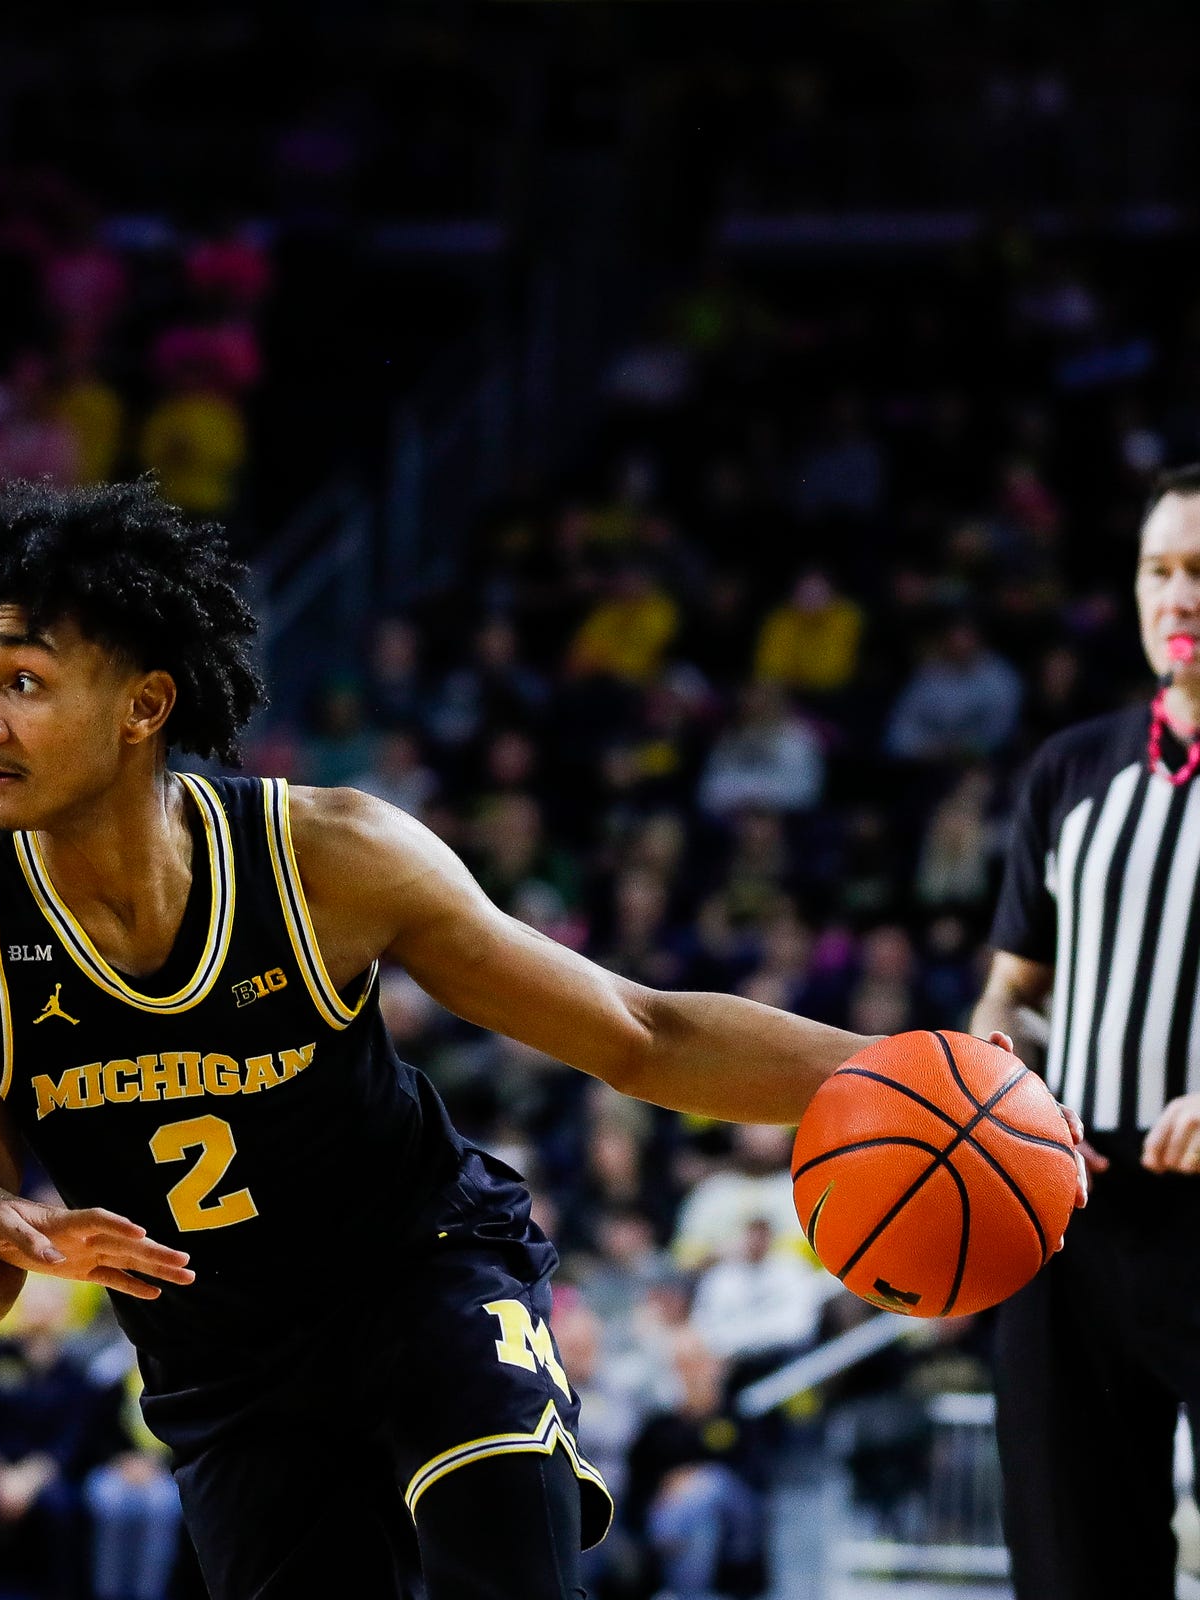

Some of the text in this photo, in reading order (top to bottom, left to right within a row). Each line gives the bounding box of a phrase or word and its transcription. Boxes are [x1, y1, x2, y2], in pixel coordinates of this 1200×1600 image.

[8, 944, 53, 962] BLM
[31, 1042, 317, 1121] MICHIGAN
[149, 1114, 259, 1232] 2
[482, 1299, 572, 1404] M
